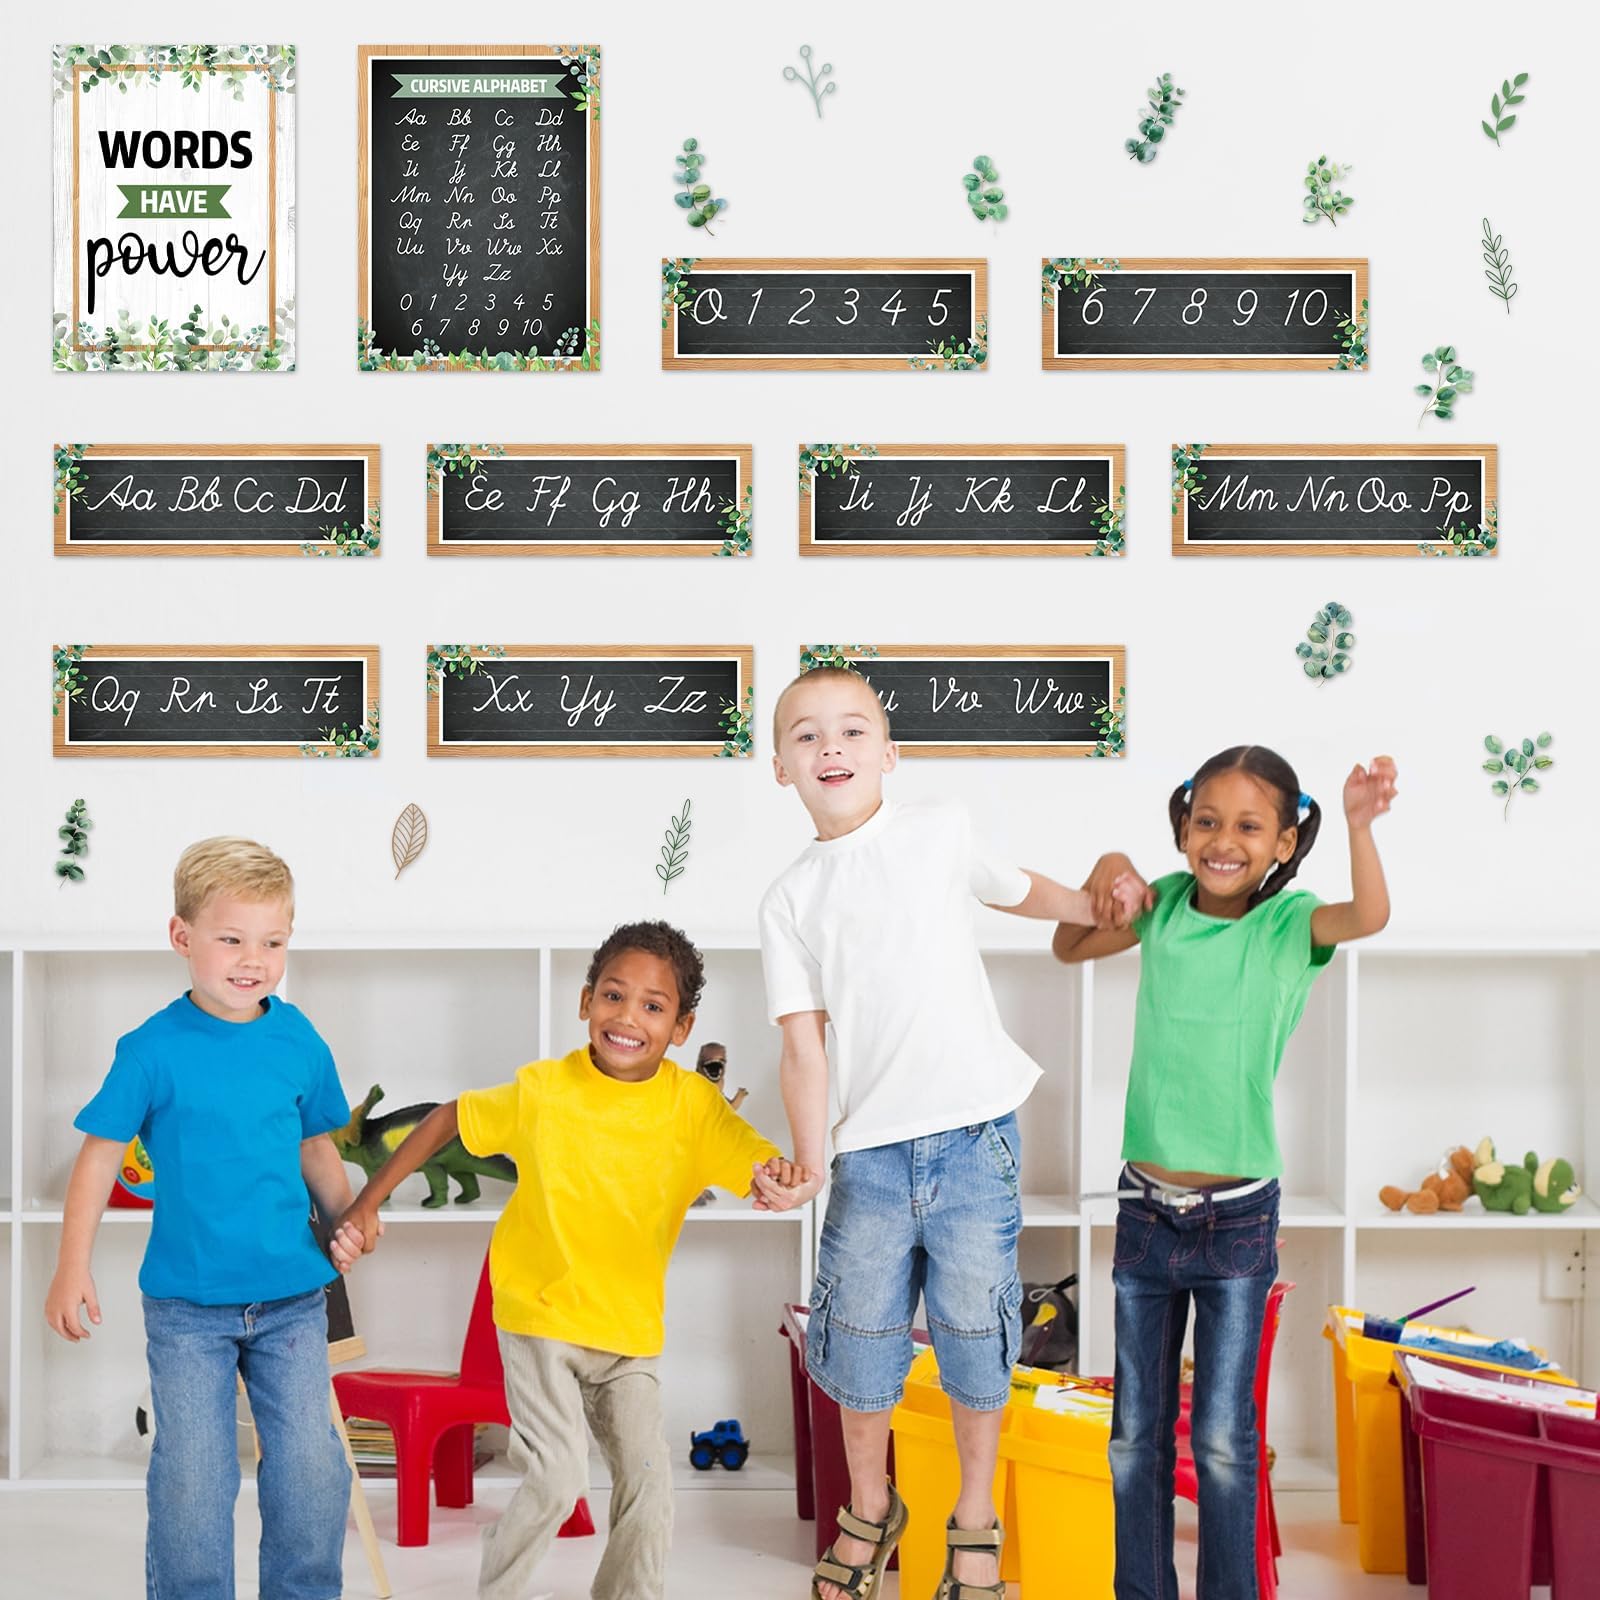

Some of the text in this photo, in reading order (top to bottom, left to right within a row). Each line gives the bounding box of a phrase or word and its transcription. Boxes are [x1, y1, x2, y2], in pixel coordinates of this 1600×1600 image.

[411, 79, 548, 93] CURSIVE ALPHABET
[394, 108, 564, 126] Aa Bb Cc Dd
[98, 130, 253, 169] WORDS
[401, 134, 562, 158] Ee Ff Gg Hh
[402, 160, 560, 184] Ii Jj Kk Ll
[140, 190, 208, 214] HAVE
[390, 186, 562, 209] Mm Nn Oo Pp
[399, 211, 559, 235] Qq Rr Ss Tt
[396, 237, 563, 256] Uu Vv Ww Xx
[86, 230, 266, 315] power
[442, 263, 511, 287] Yy Zz
[400, 293, 554, 311] 0 1 2 3 4 5
[747, 288, 763, 325] 1
[788, 288, 816, 325] 2
[836, 288, 860, 325] 3
[881, 289, 907, 326] 4
[928, 289, 952, 326] 5
[1082, 288, 1328, 326] 6 7 8 9 10
[411, 318, 542, 336] 6 7 8 9 10
[86, 475, 347, 513] Aa Bb Cc Dd
[465, 475, 716, 528] Ee Ff Gg Hh
[839, 474, 1086, 527] Ii Jj Kk Ll
[1198, 474, 1472, 528] Mm Nn Oo Pp
[91, 675, 342, 727] Qq Rr Ss Tt
[473, 675, 708, 727] Xx Yy Zz
[929, 677, 983, 713] Vv
[1013, 678, 1084, 715] Ww
